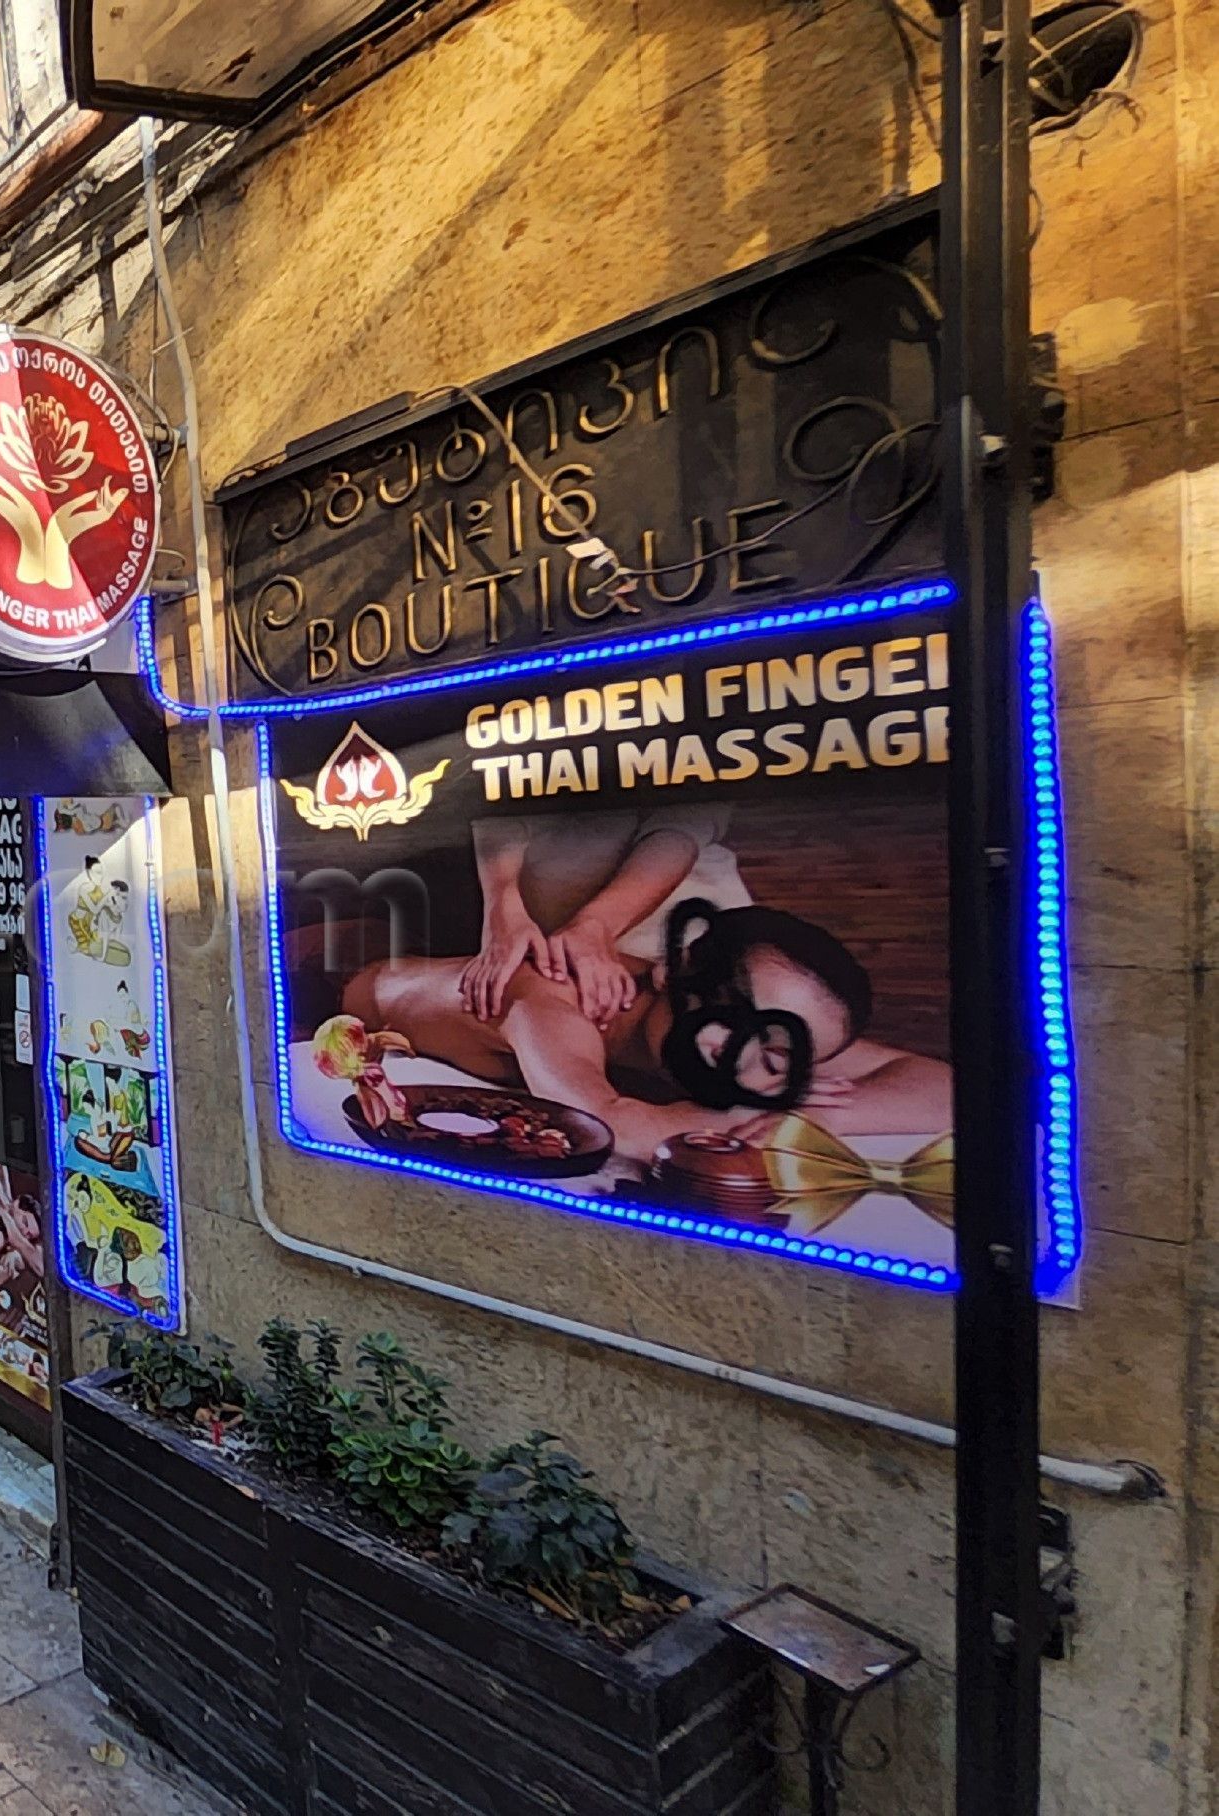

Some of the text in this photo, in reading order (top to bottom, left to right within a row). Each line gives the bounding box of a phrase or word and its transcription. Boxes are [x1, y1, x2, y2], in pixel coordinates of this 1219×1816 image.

[12, 346, 86, 389] ოქროს
[89, 381, 148, 493] თითებით
[53, 597, 98, 629] THAI
[98, 517, 148, 613] MASSAGE
[308, 499, 792, 683] BOUTIQUE
[466, 675, 686, 751] GOLDEN
[472, 746, 599, 801] THAI
[9, 882, 26, 906] 96
